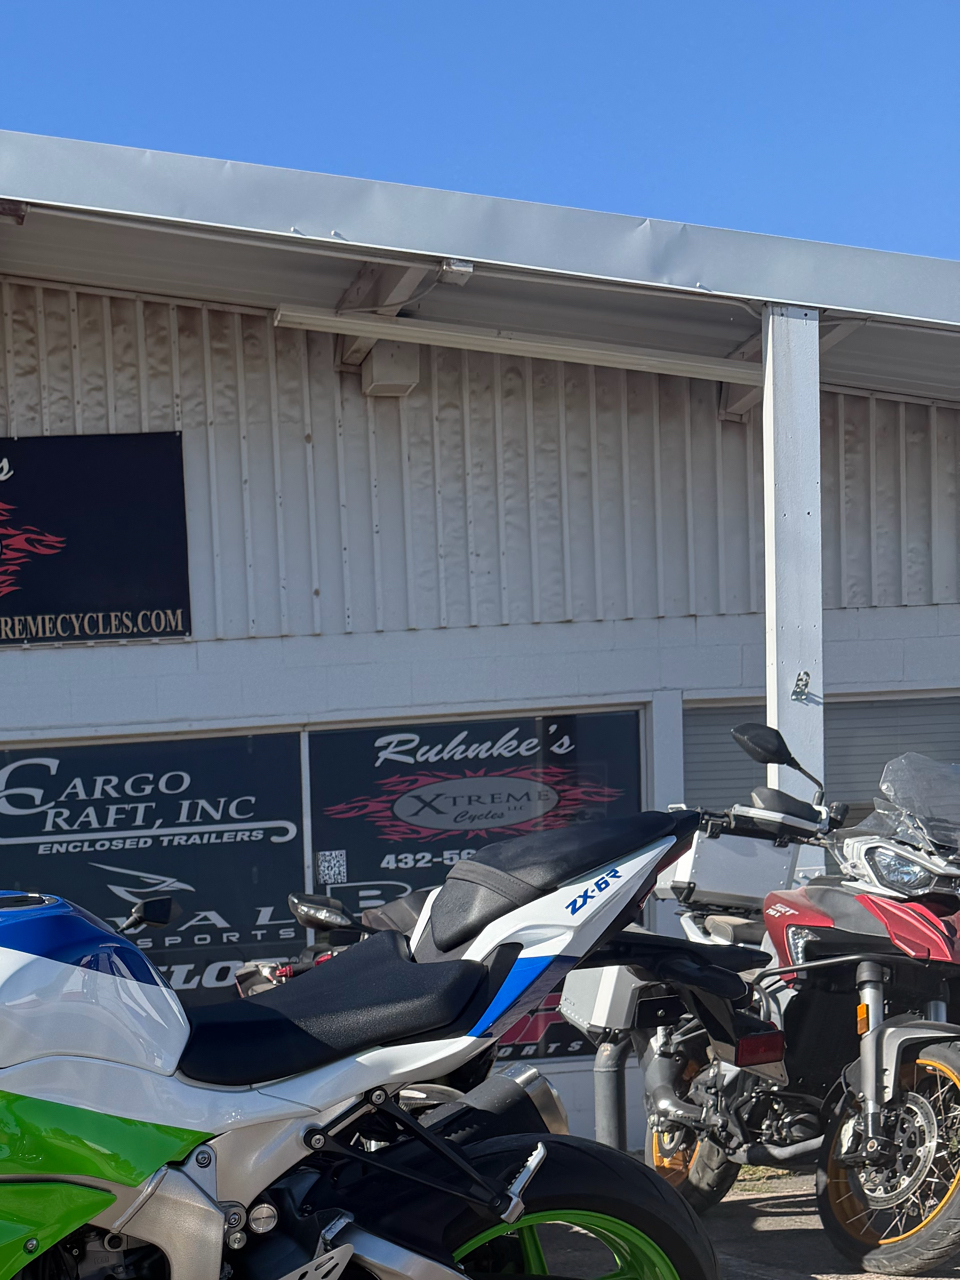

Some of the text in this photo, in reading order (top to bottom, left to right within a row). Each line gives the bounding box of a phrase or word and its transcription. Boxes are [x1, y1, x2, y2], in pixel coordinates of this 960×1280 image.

[374, 724, 575, 768] Ruhnke's
[178, 796, 256, 823] INC
[407, 789, 551, 818] XTREME
[453, 804, 526, 824] Cycles LLC
[38, 830, 264, 855] ENCLOSED TRAILERS
[565, 868, 624, 917] ZX-6R
